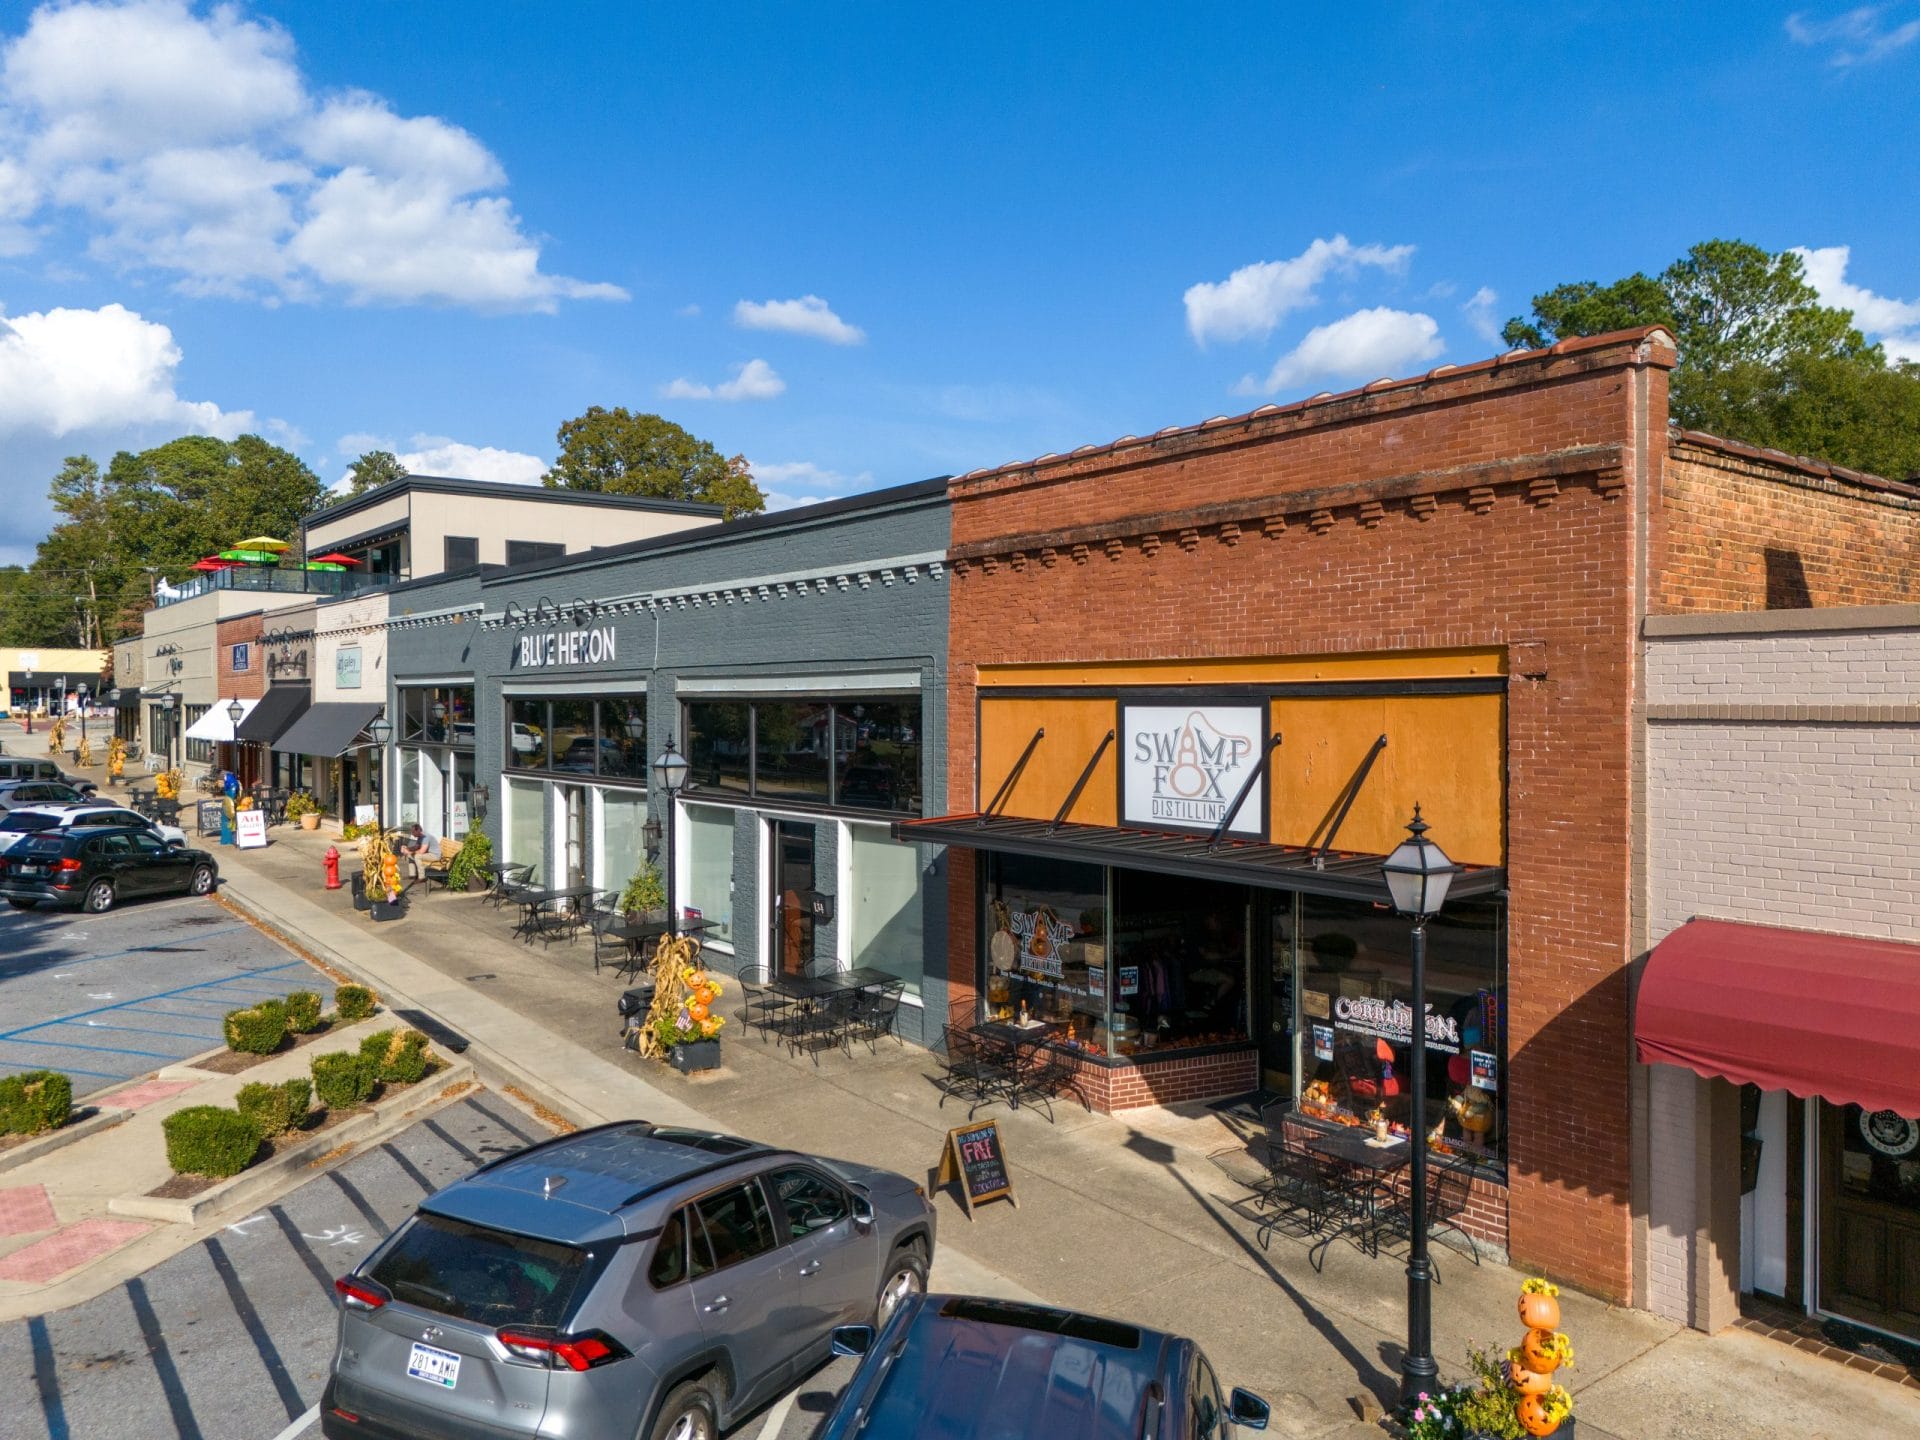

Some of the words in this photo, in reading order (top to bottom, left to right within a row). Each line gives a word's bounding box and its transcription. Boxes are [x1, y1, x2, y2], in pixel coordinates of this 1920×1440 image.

[521, 633, 555, 667] BLUE
[558, 626, 616, 664] HERON
[1134, 724, 1252, 769] SWAMP
[1152, 764, 1226, 799] FOX
[242, 815, 260, 823] Art
[1152, 800, 1226, 822] DISTILLING
[962, 1138, 995, 1164] FREE
[411, 1352, 429, 1370] 281
